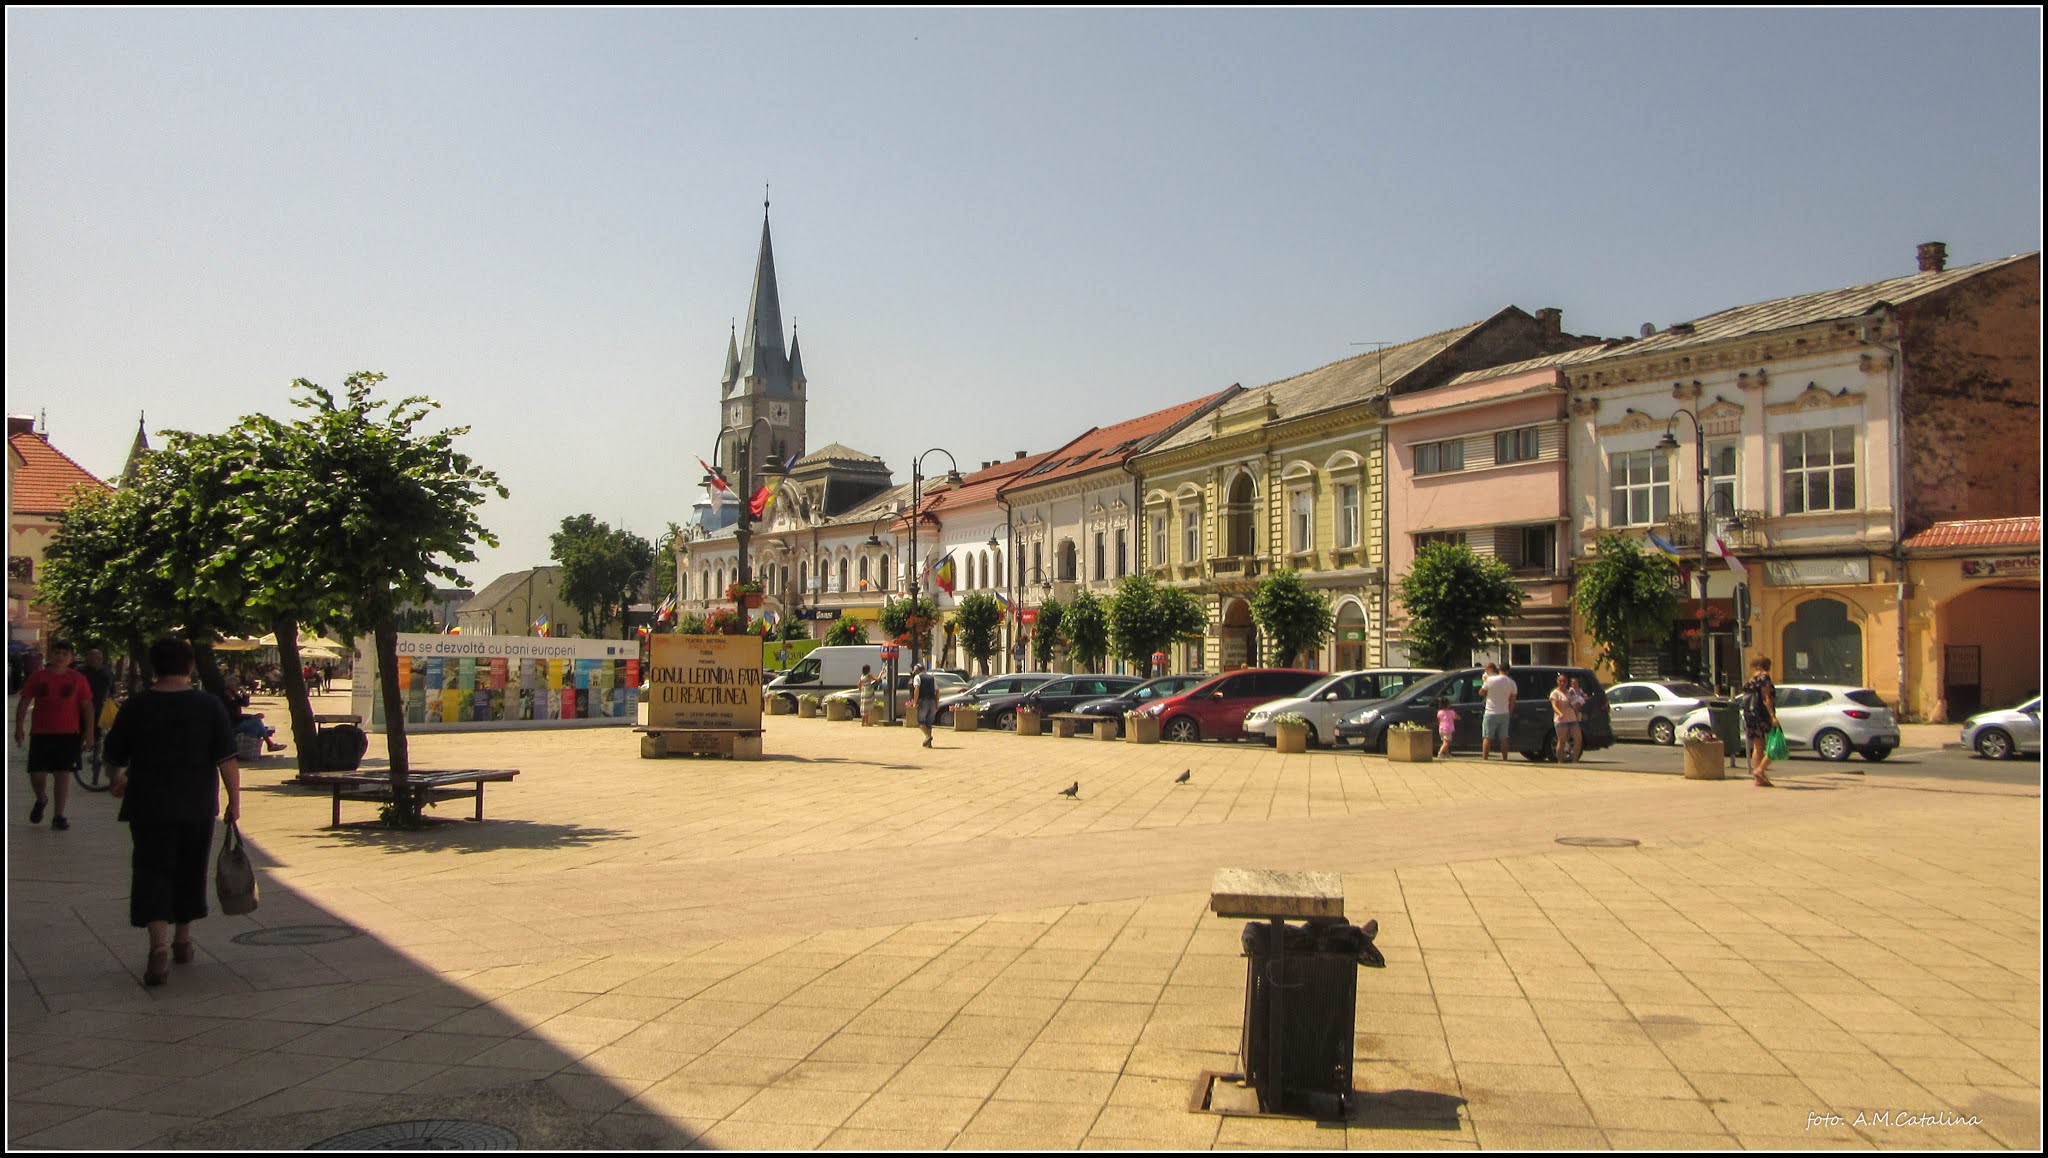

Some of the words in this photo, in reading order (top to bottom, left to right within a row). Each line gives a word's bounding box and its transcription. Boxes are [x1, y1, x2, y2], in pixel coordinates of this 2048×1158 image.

[419, 642, 433, 653] se
[435, 641, 485, 654] dezvoltă
[489, 644, 501, 655] cu
[505, 642, 529, 655] bani
[531, 643, 576, 657] europeni
[651, 667, 685, 684] CONUL
[689, 666, 734, 685] LEONIDA
[663, 686, 679, 704] CU
